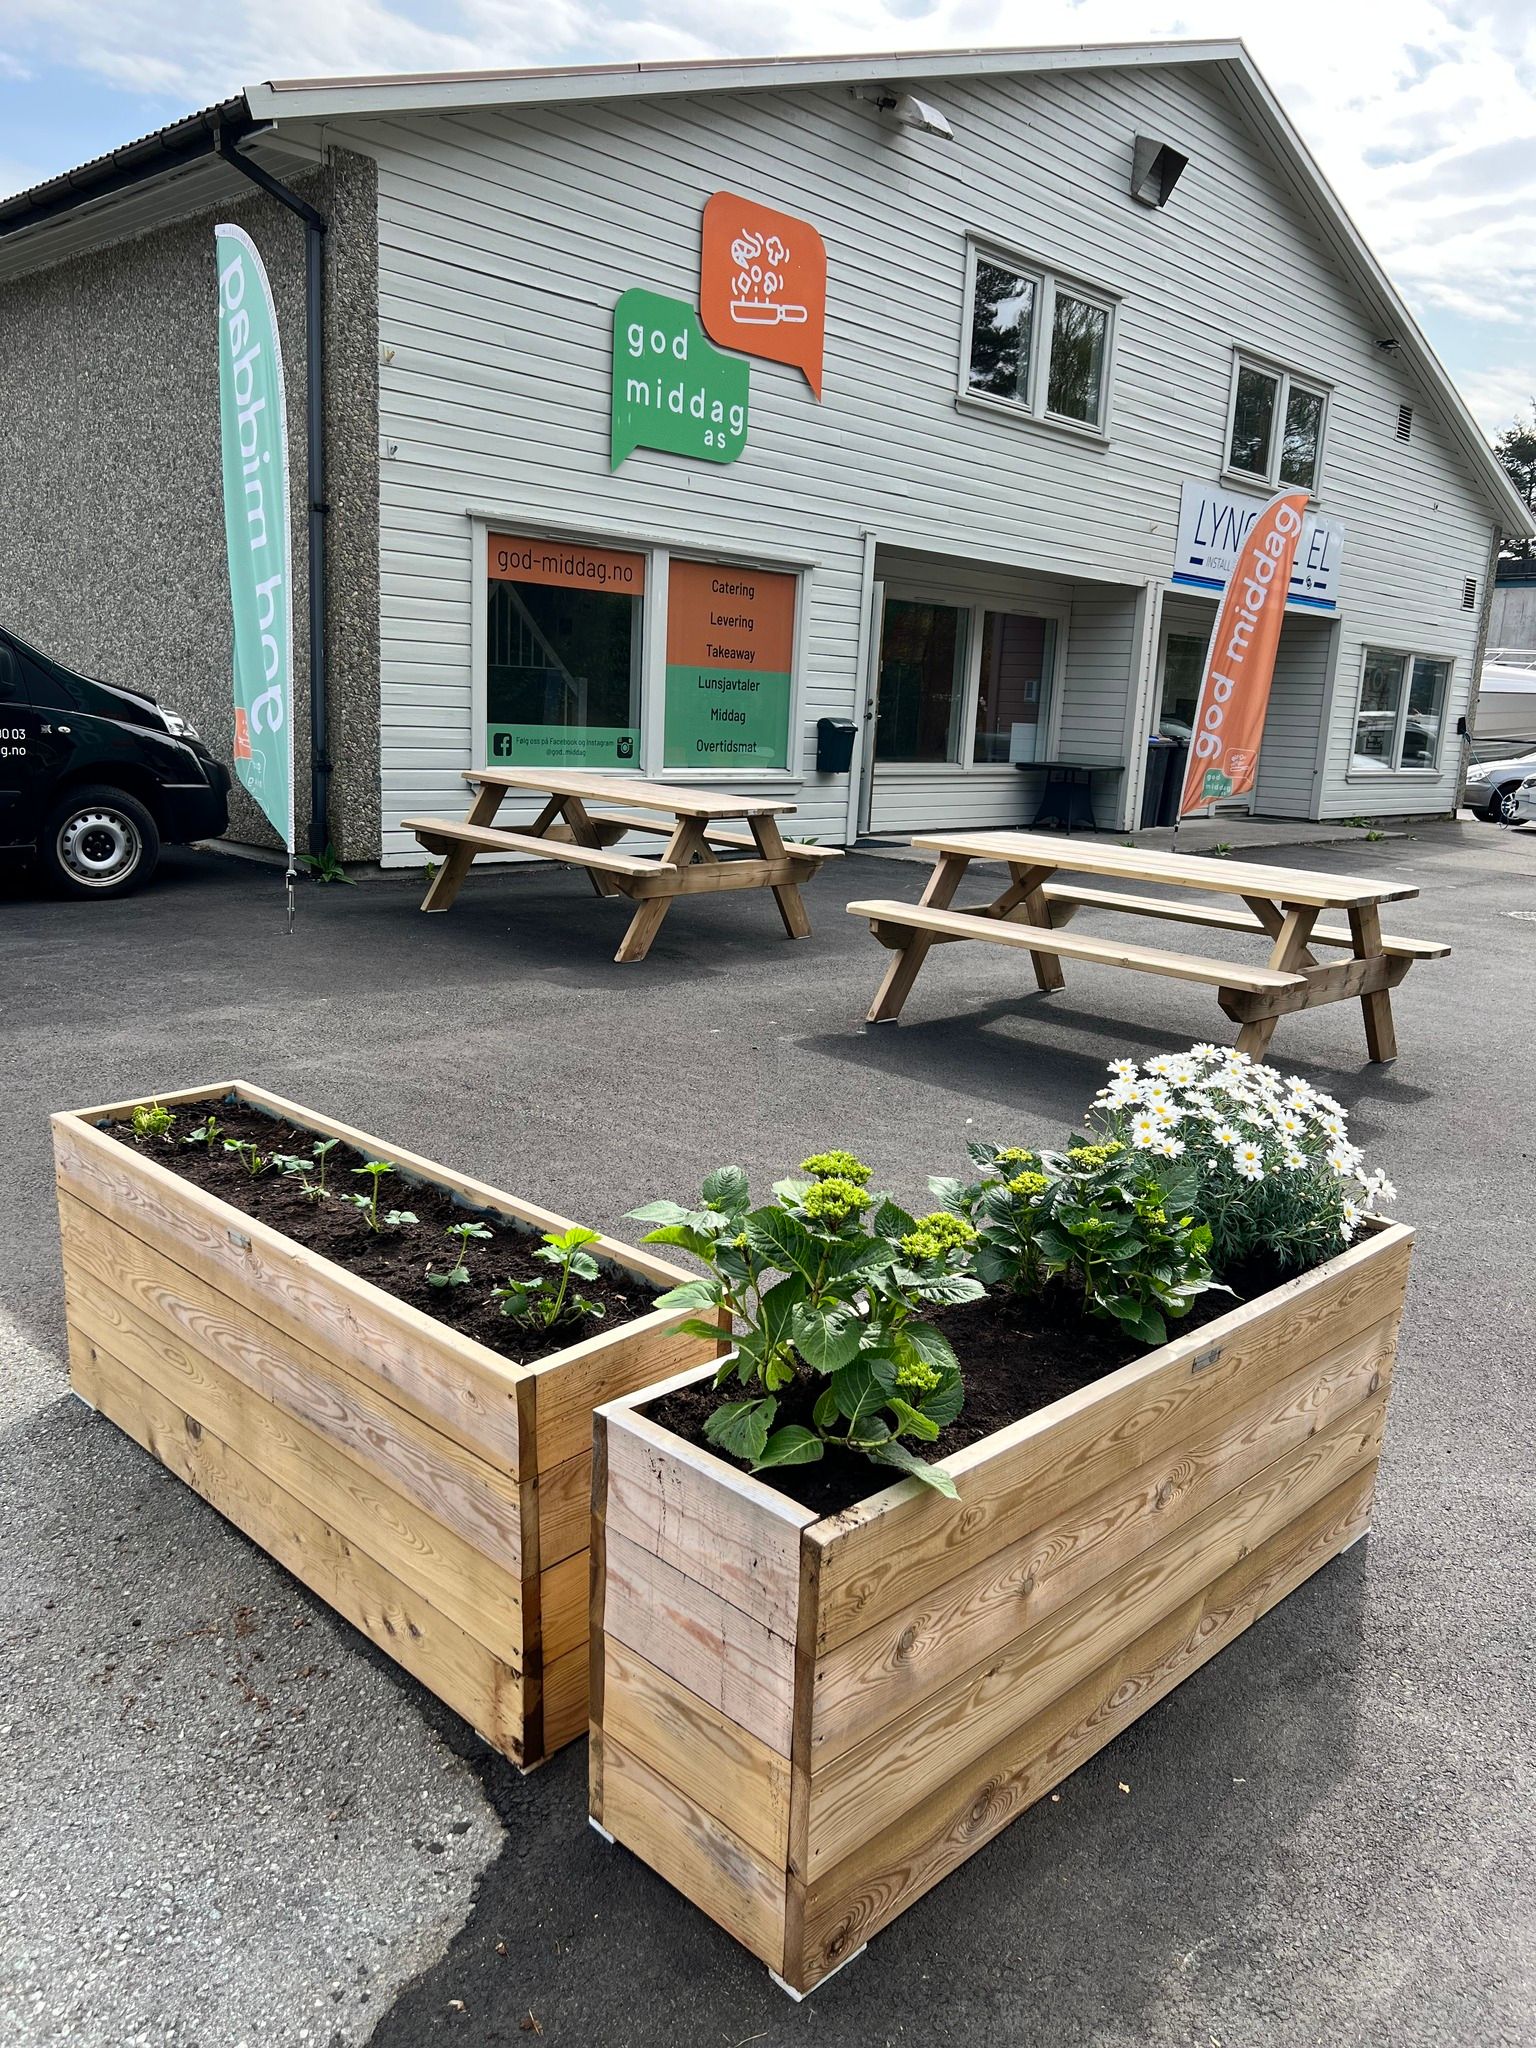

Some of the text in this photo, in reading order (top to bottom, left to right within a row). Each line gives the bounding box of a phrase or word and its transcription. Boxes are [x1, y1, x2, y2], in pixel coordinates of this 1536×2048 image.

[627, 323, 688, 361] god
[627, 379, 744, 436] middag
[704, 429, 726, 448] as
[1307, 529, 1330, 572] EL
[497, 549, 633, 584] god-middag.no
[1206, 556, 1231, 572] INSTALL
[712, 579, 755, 600] Catering
[710, 611, 754, 632] Levering
[1196, 502, 1302, 760] god middag
[706, 644, 755, 663] Takeaway
[698, 675, 760, 693] Lunsjavtaler
[711, 708, 746, 725] Middag
[516, 736, 529, 746] Følg
[541, 737, 549, 746] på
[549, 738, 578, 746] Facebook
[578, 739, 586, 747] og
[586, 739, 614, 748] Instagram
[696, 739, 757, 752] Overtidsmat
